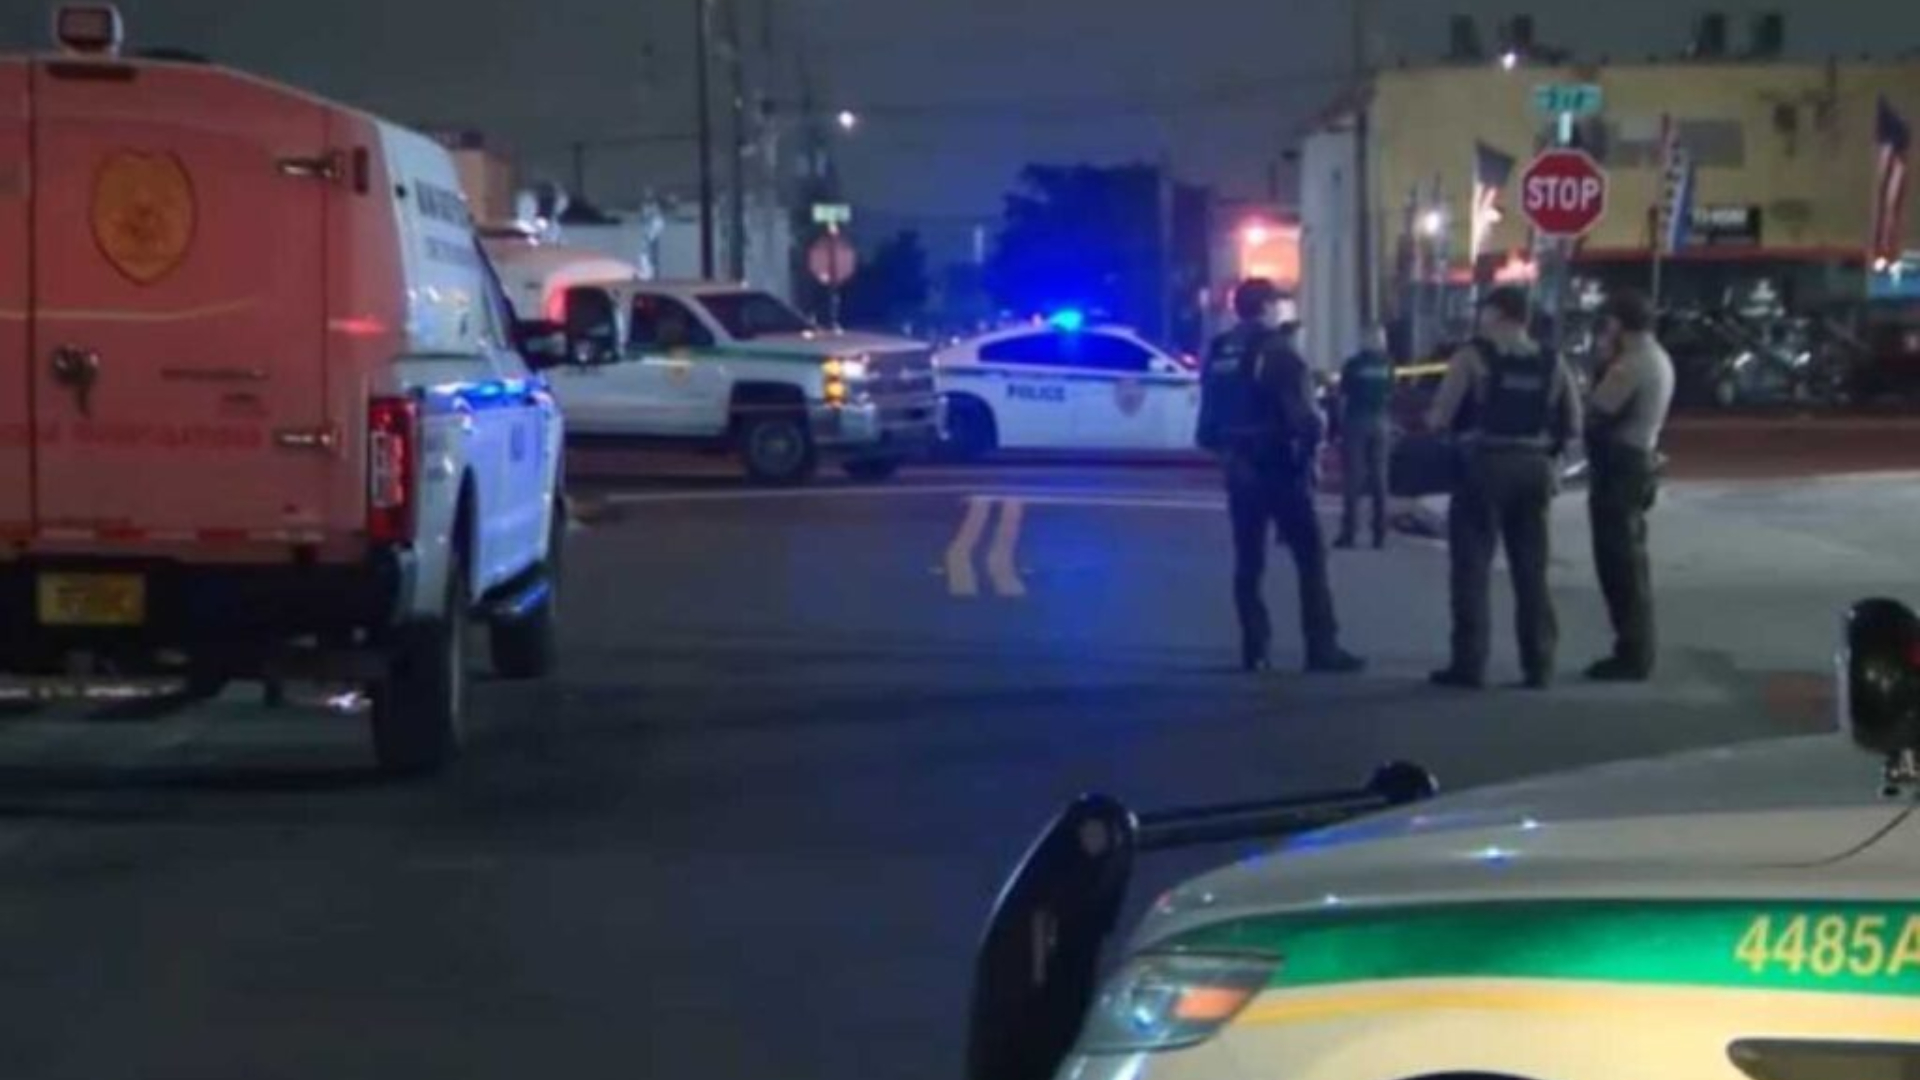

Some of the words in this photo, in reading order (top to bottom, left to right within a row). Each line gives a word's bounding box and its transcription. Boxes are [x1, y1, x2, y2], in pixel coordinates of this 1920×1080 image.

[1527, 175, 1600, 211] STOP
[1006, 383, 1066, 403] POLICE
[1735, 914, 1920, 976] 4485A
